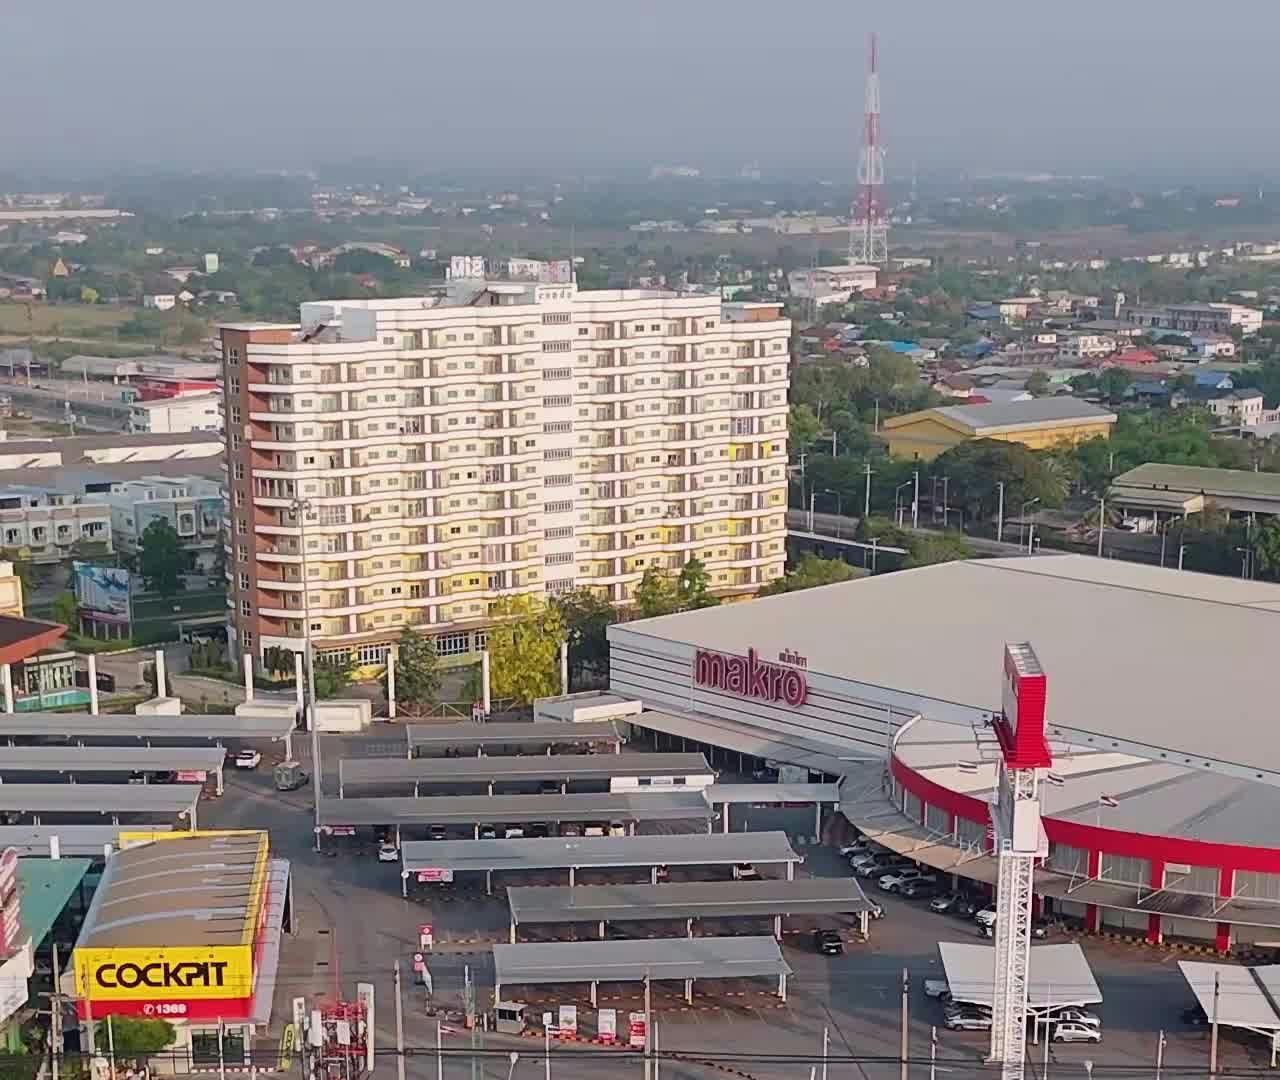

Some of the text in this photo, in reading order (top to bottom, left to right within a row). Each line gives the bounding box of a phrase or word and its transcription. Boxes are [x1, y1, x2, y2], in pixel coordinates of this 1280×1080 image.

[696, 647, 806, 707] makro
[95, 961, 228, 988] COCKPIT
[156, 1004, 187, 1014] 1369
